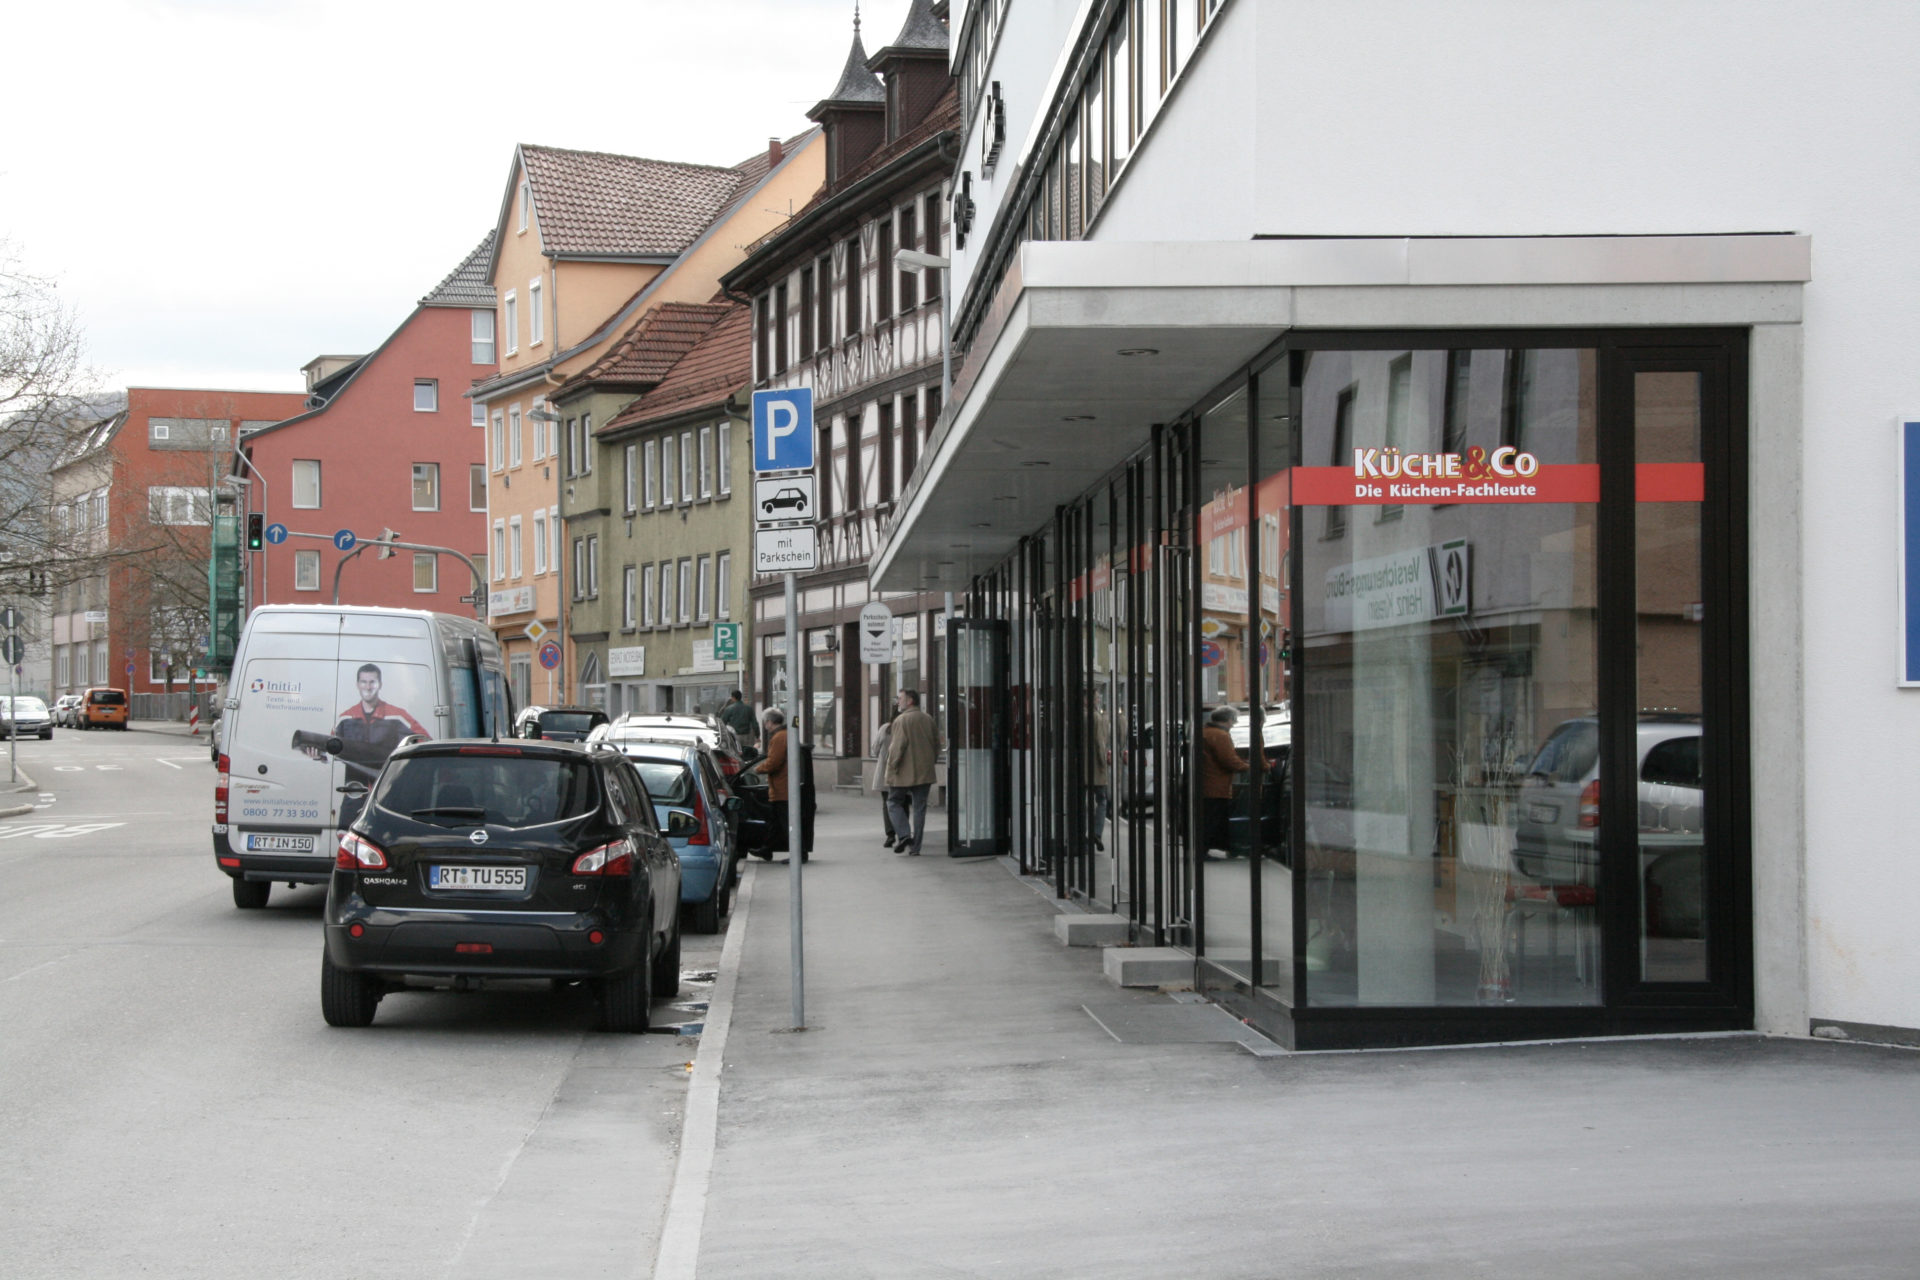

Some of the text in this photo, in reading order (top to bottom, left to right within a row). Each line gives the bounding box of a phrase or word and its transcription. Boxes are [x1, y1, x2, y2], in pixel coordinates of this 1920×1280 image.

[766, 399, 799, 461] P
[1355, 483, 1537, 497] Die Küchen-Fachleute
[777, 538, 793, 549] mit
[760, 550, 811, 564] Parkschein
[717, 626, 732, 648] P
[267, 681, 302, 693] Initial
[243, 808, 319, 818] 0800 77 33 300
[254, 836, 311, 849] RT IN 150
[363, 877, 408, 885] QASHQAI+2
[439, 867, 525, 885] RT TU 555
